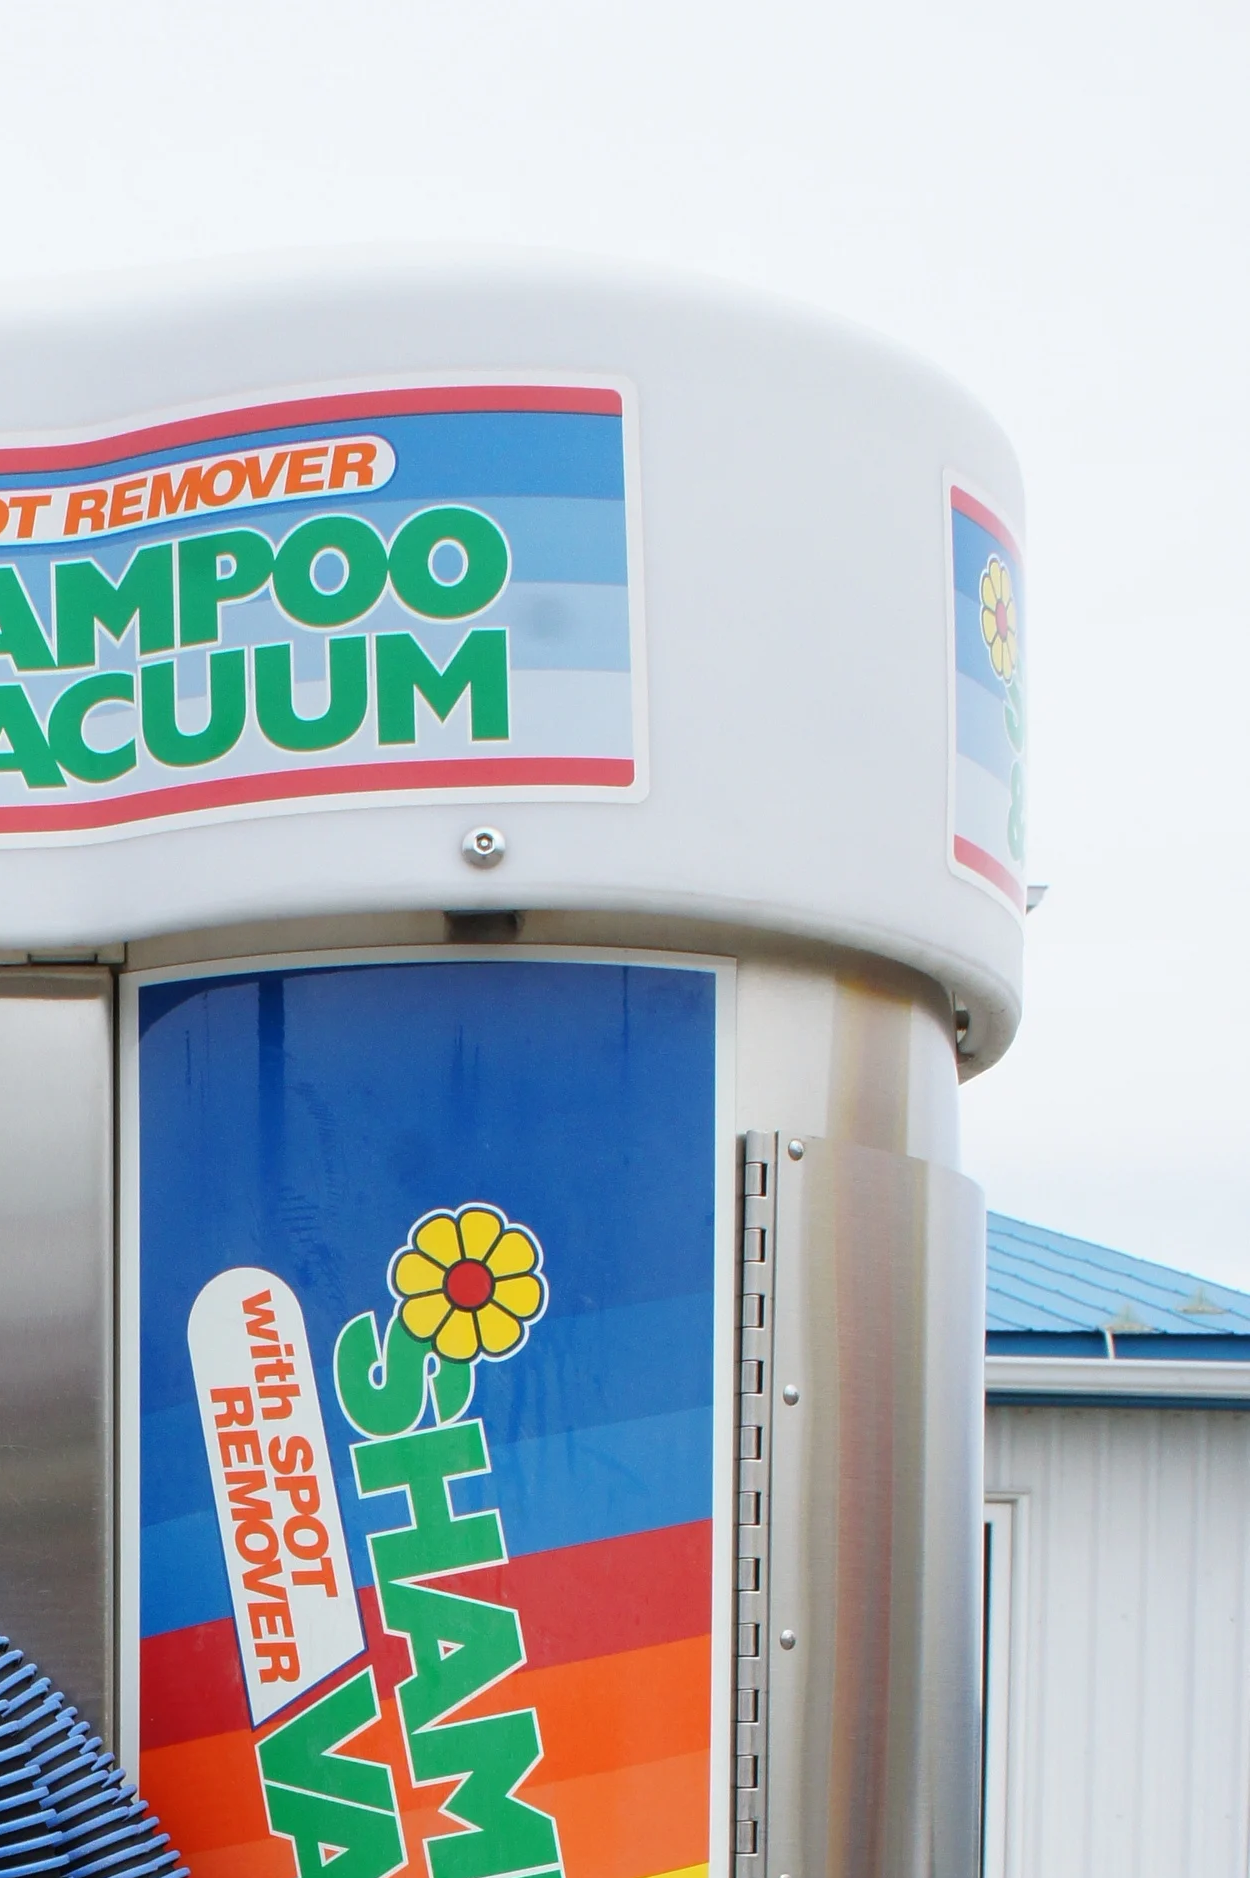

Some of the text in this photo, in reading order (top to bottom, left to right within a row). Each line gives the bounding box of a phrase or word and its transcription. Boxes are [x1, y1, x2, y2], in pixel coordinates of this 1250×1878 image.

[63, 441, 377, 537] REMOVER
[209, 1385, 302, 1686] REMOVER
[240, 1288, 338, 1598] with SPOT
